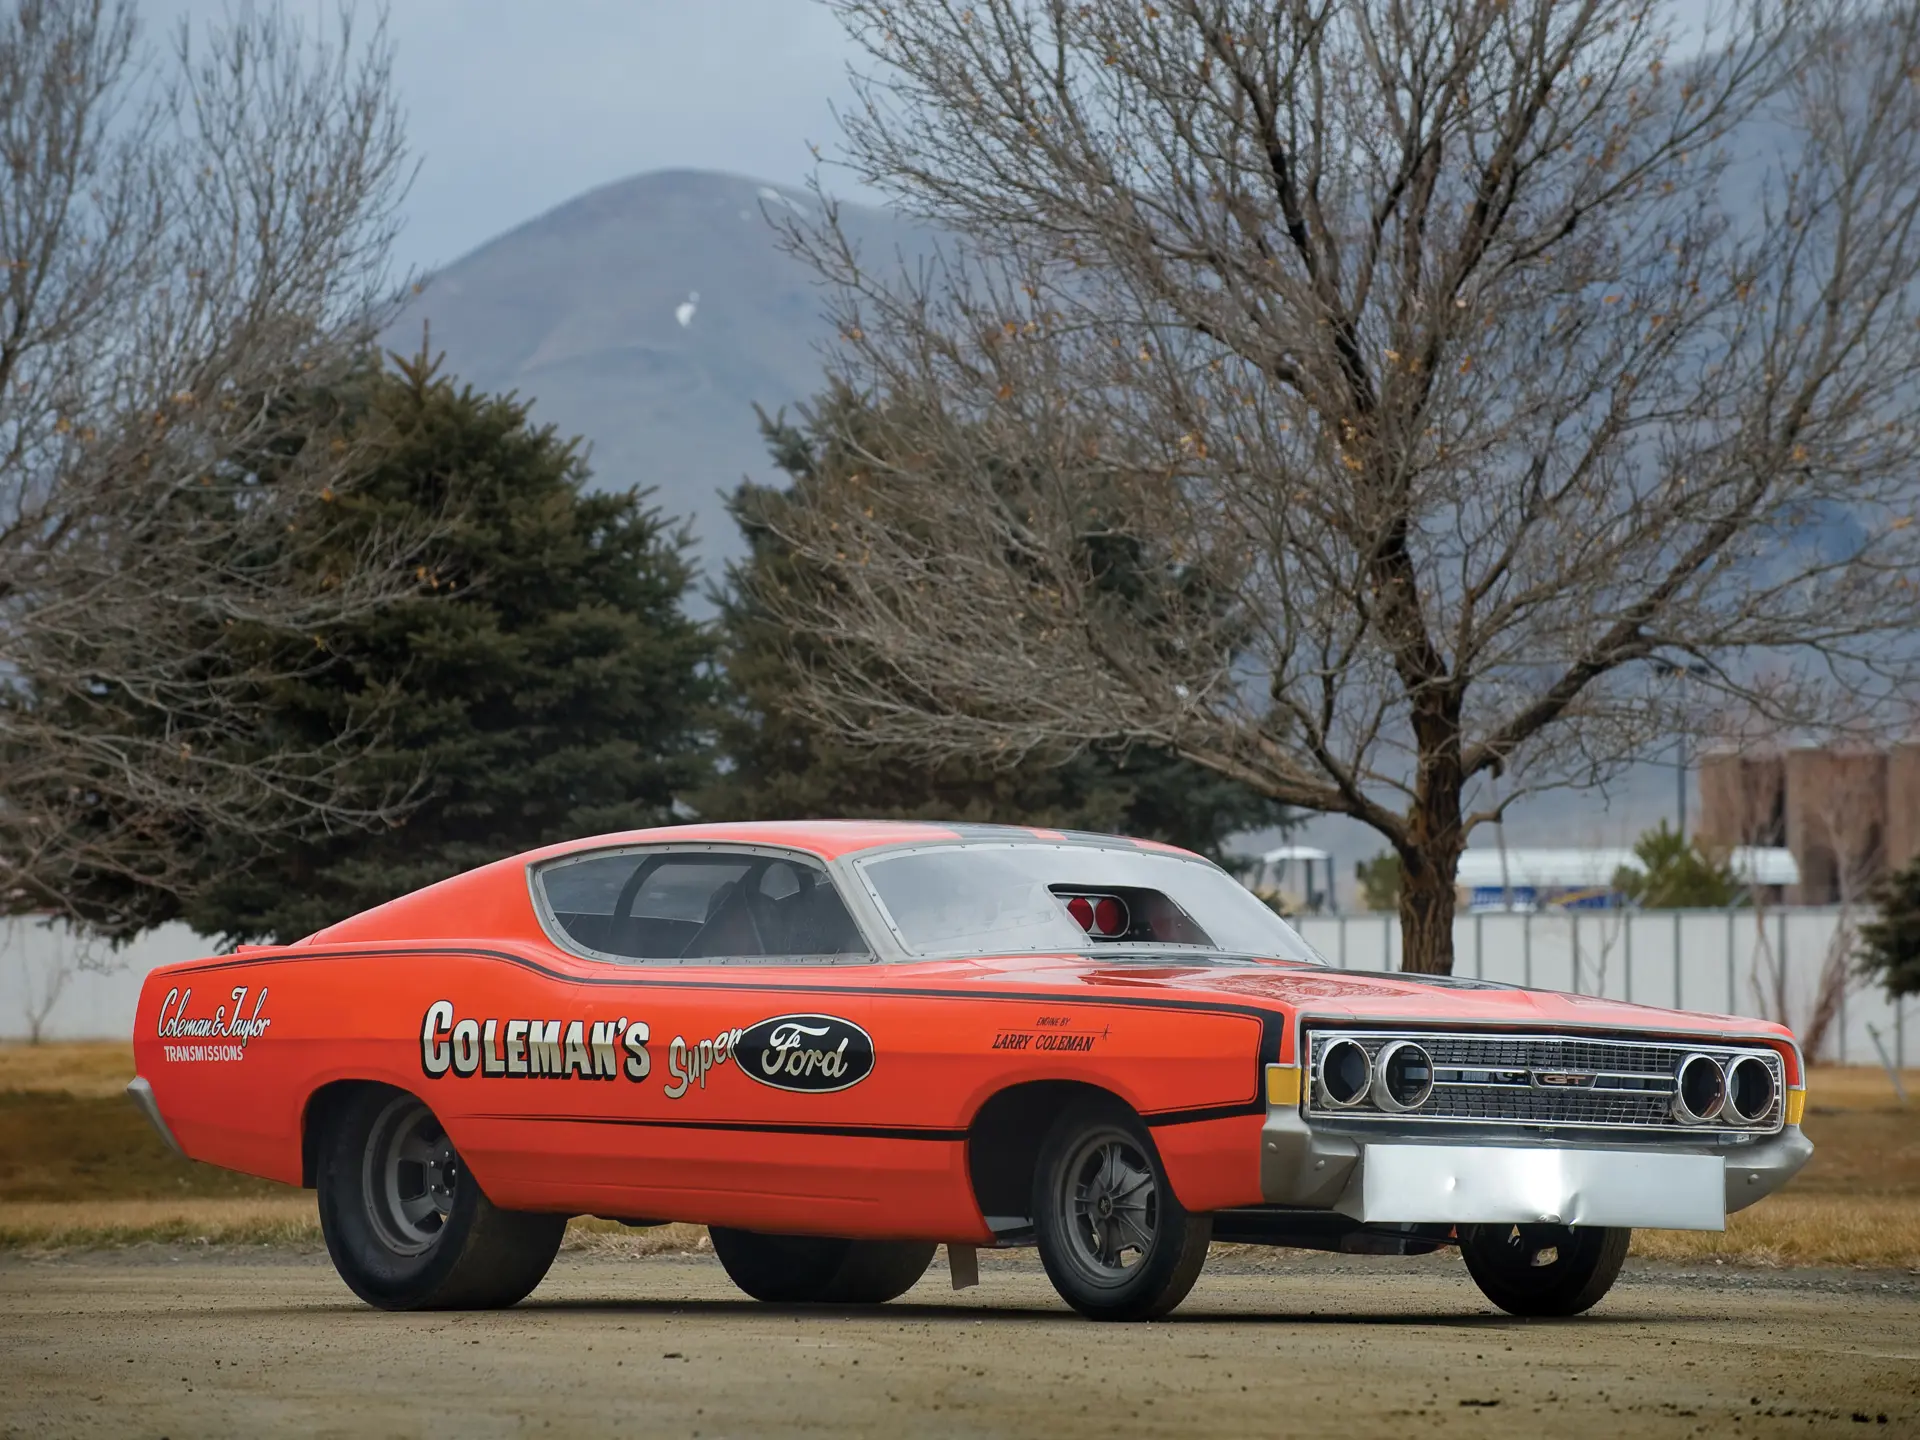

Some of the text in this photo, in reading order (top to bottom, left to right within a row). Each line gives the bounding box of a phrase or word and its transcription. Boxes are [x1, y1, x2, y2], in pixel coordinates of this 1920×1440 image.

[1060, 1017, 1071, 1027] BY
[420, 1000, 849, 1099] COLEMAN'S Super Ford
[992, 1033, 1095, 1051] LARRY COLEMAN
[163, 1045, 244, 1062] TRANSMISSIONS
